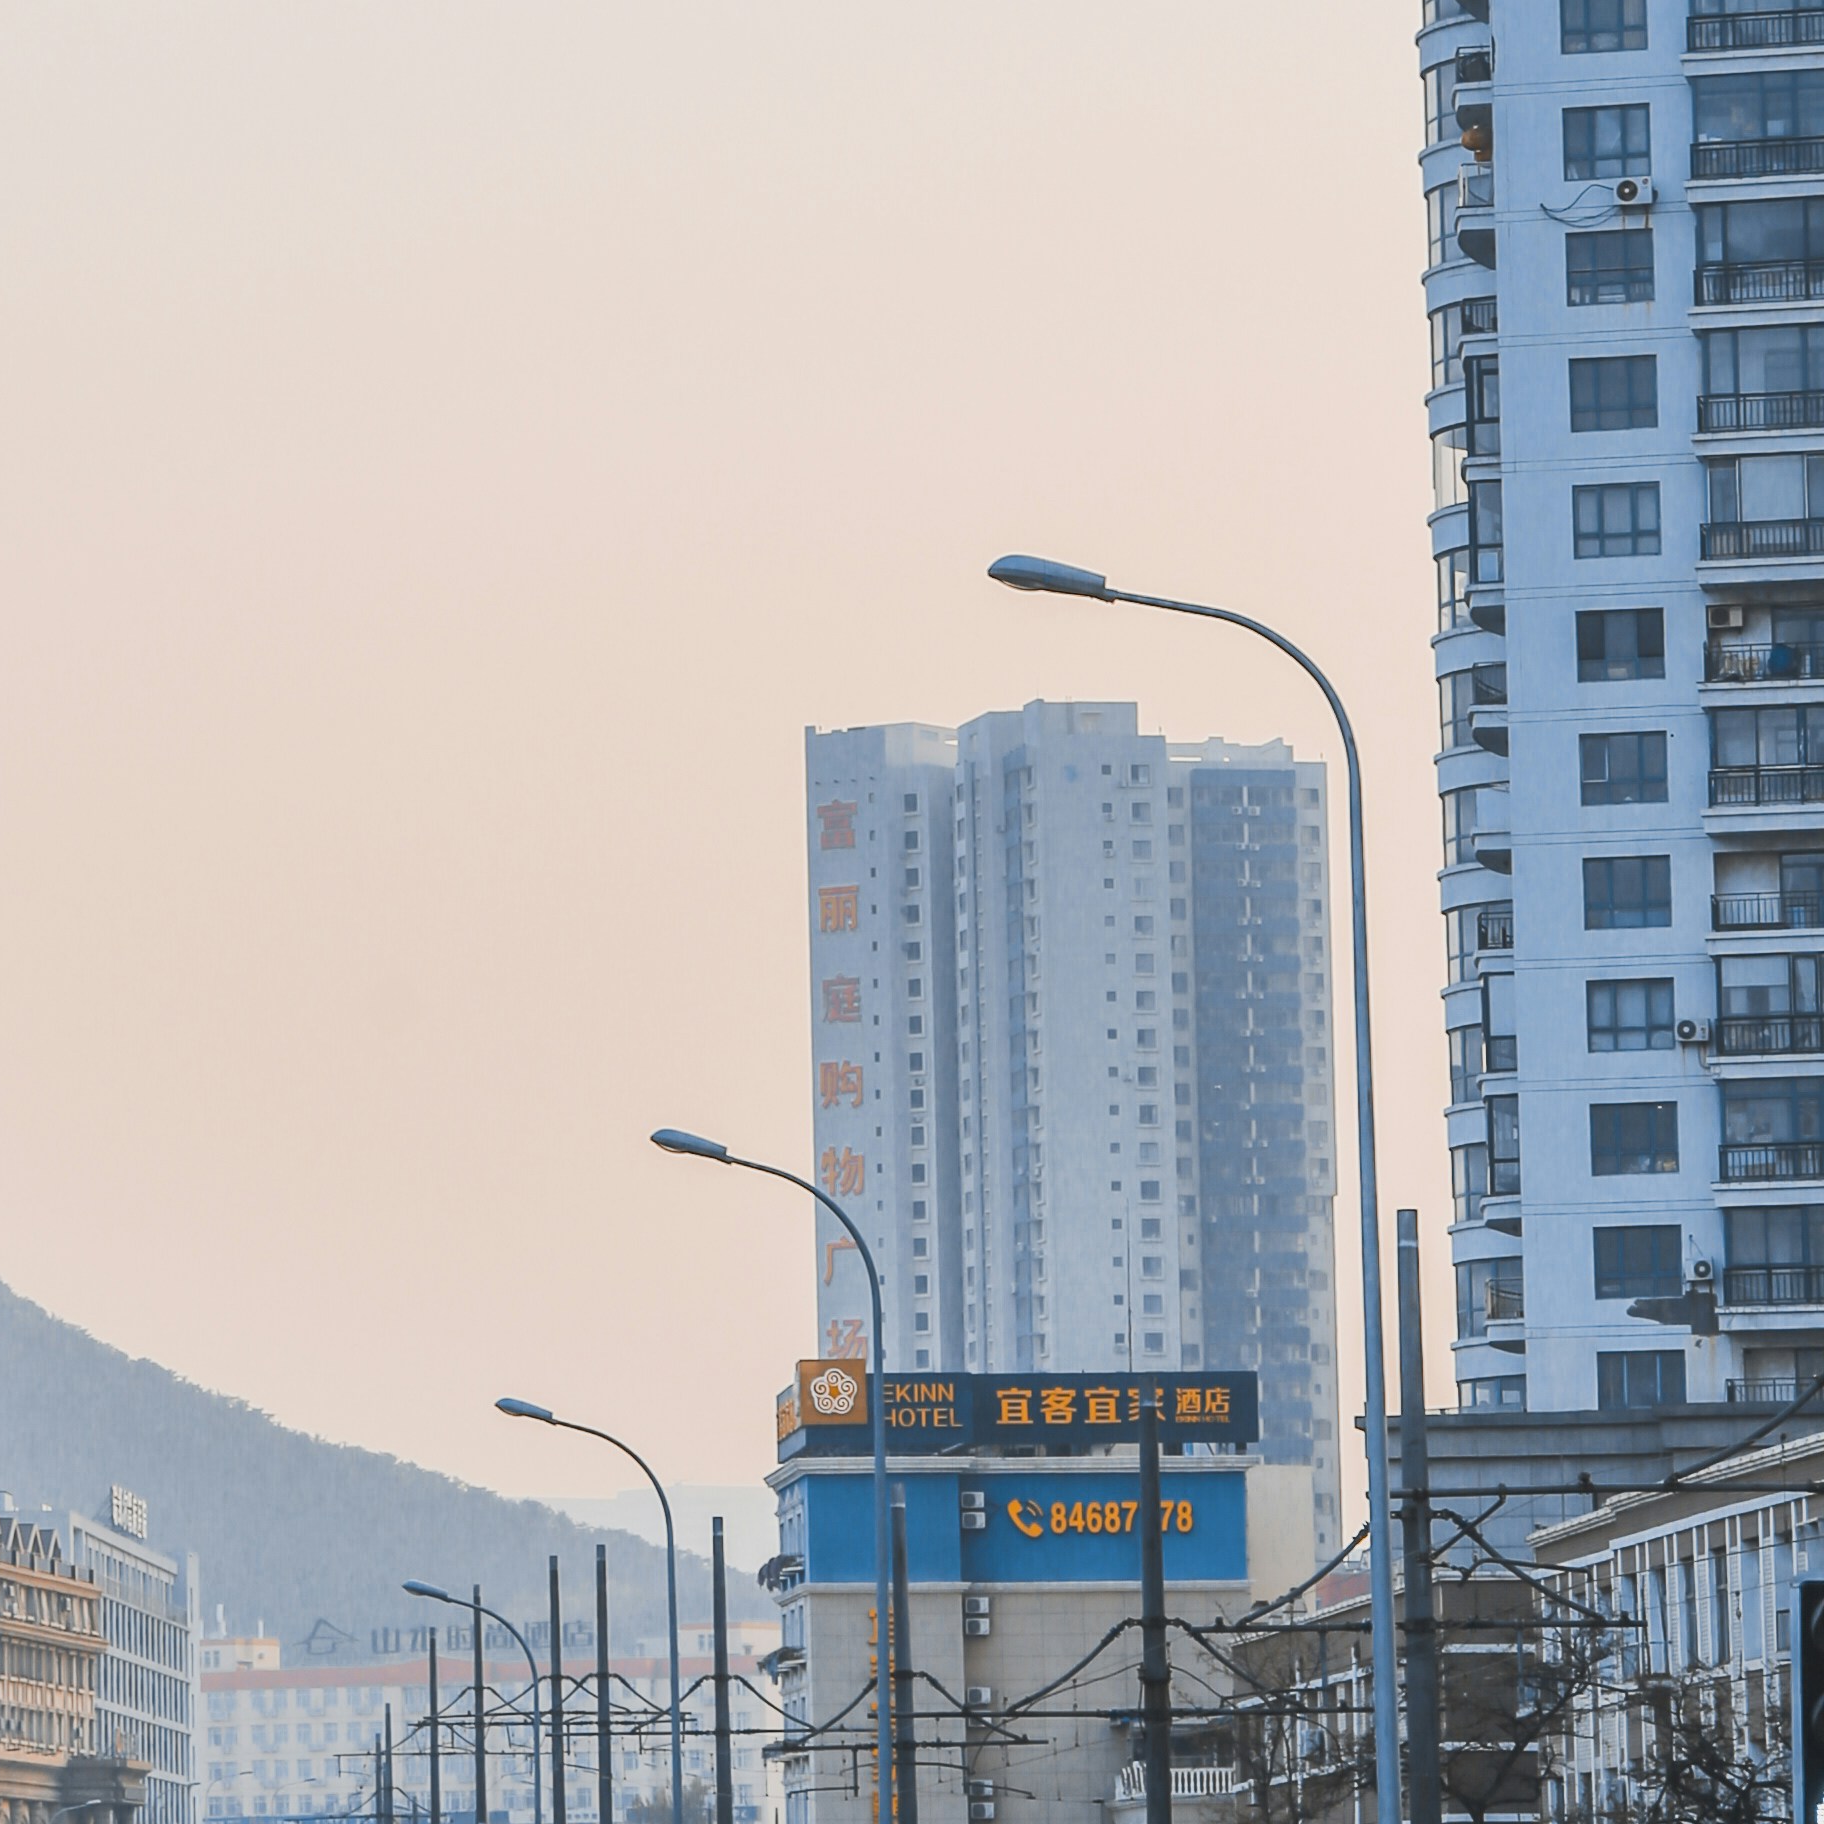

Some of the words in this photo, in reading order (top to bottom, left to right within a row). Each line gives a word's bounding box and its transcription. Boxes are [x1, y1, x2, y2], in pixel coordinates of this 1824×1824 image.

[816, 799, 871, 1360] 富丽庭购物广场
[1176, 1387, 1230, 1414] 酒店
[1050, 1501, 1193, 1534] 8468778
